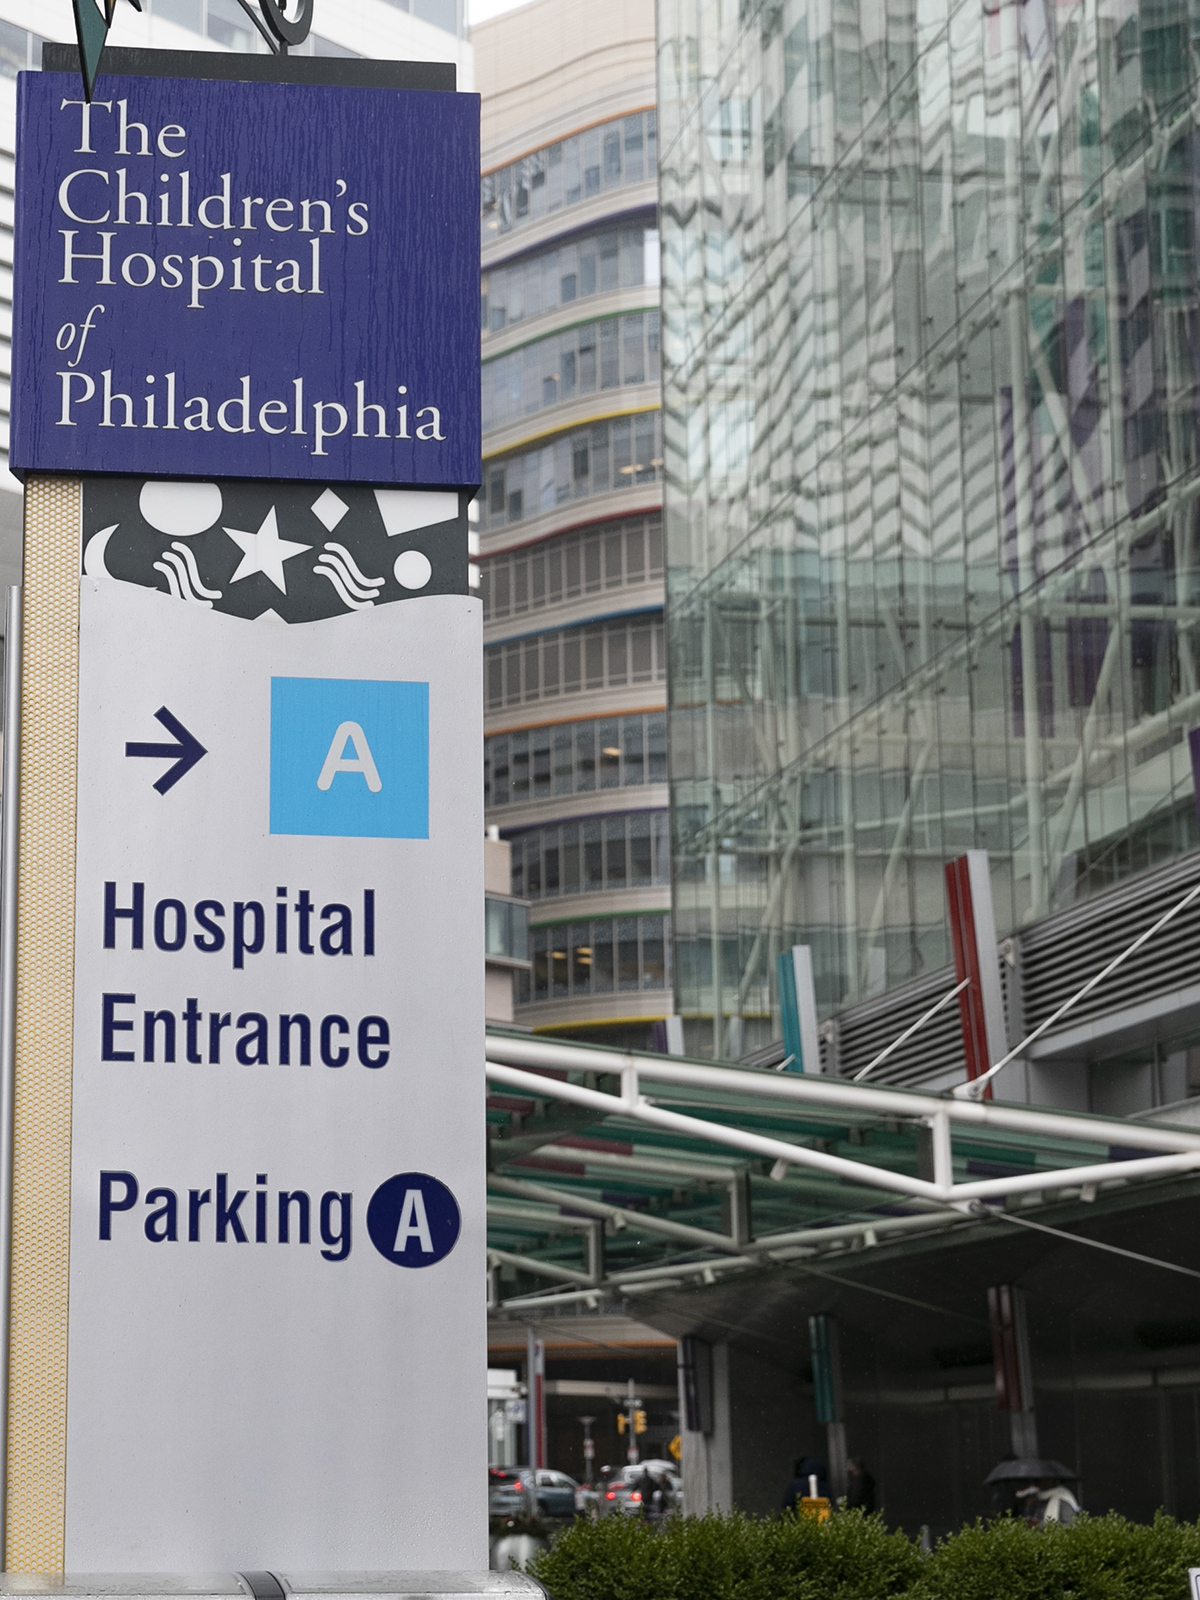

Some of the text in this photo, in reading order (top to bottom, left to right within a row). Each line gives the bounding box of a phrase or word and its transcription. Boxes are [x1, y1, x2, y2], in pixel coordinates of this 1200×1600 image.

[60, 98, 186, 157] The
[58, 168, 369, 235] Children's
[58, 230, 324, 308] Hospital
[56, 304, 105, 367] of
[55, 370, 447, 455] Philadelphia
[316, 720, 383, 793] A
[103, 881, 376, 970] Hospital
[100, 993, 392, 1070] Entrance
[99, 1169, 435, 1262] Parking A
